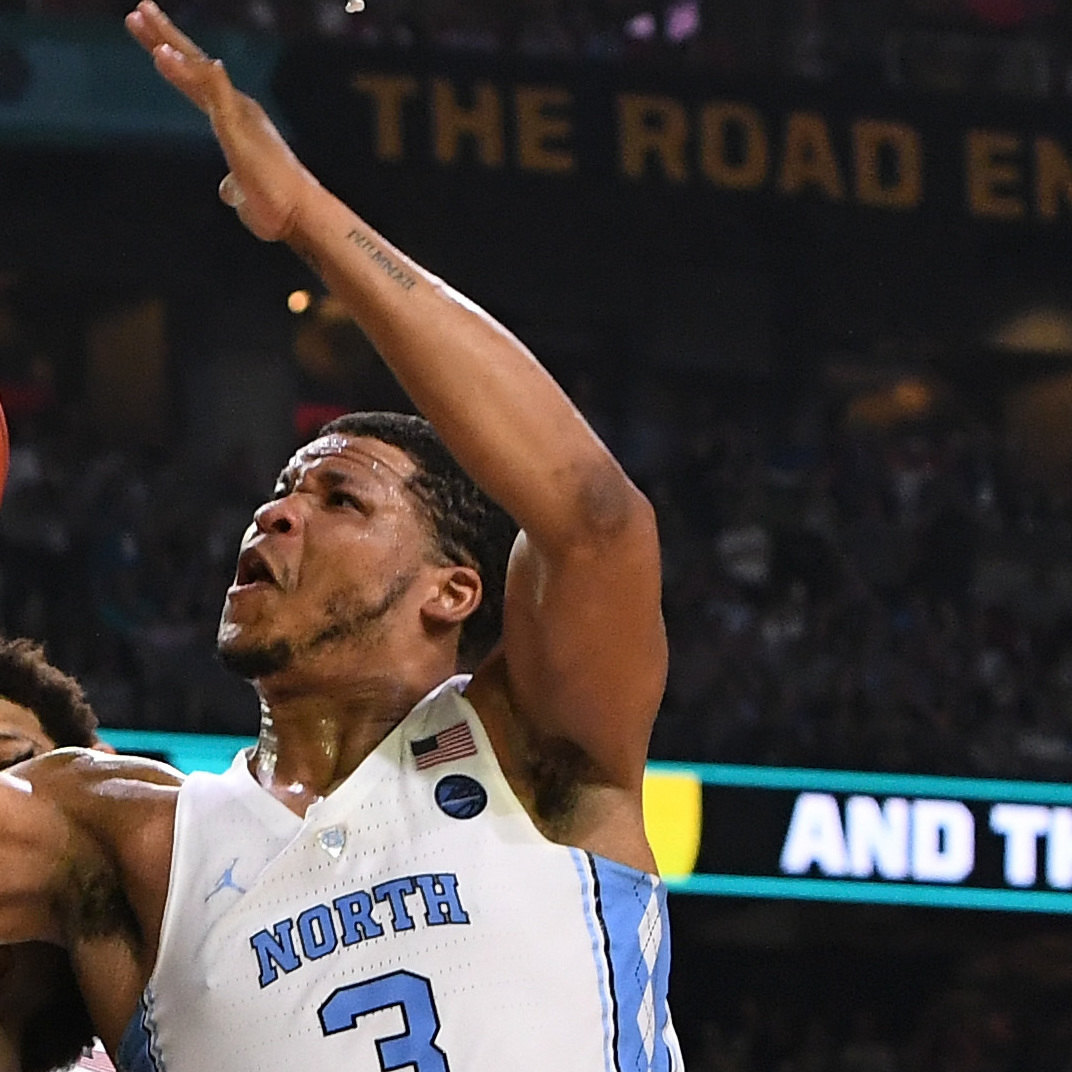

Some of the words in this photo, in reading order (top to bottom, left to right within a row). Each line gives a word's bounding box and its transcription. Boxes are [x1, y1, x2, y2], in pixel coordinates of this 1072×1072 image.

[352, 72, 576, 173] THE
[617, 92, 924, 209] ROAD
[779, 791, 975, 884] AND
[249, 872, 471, 989] NORTH
